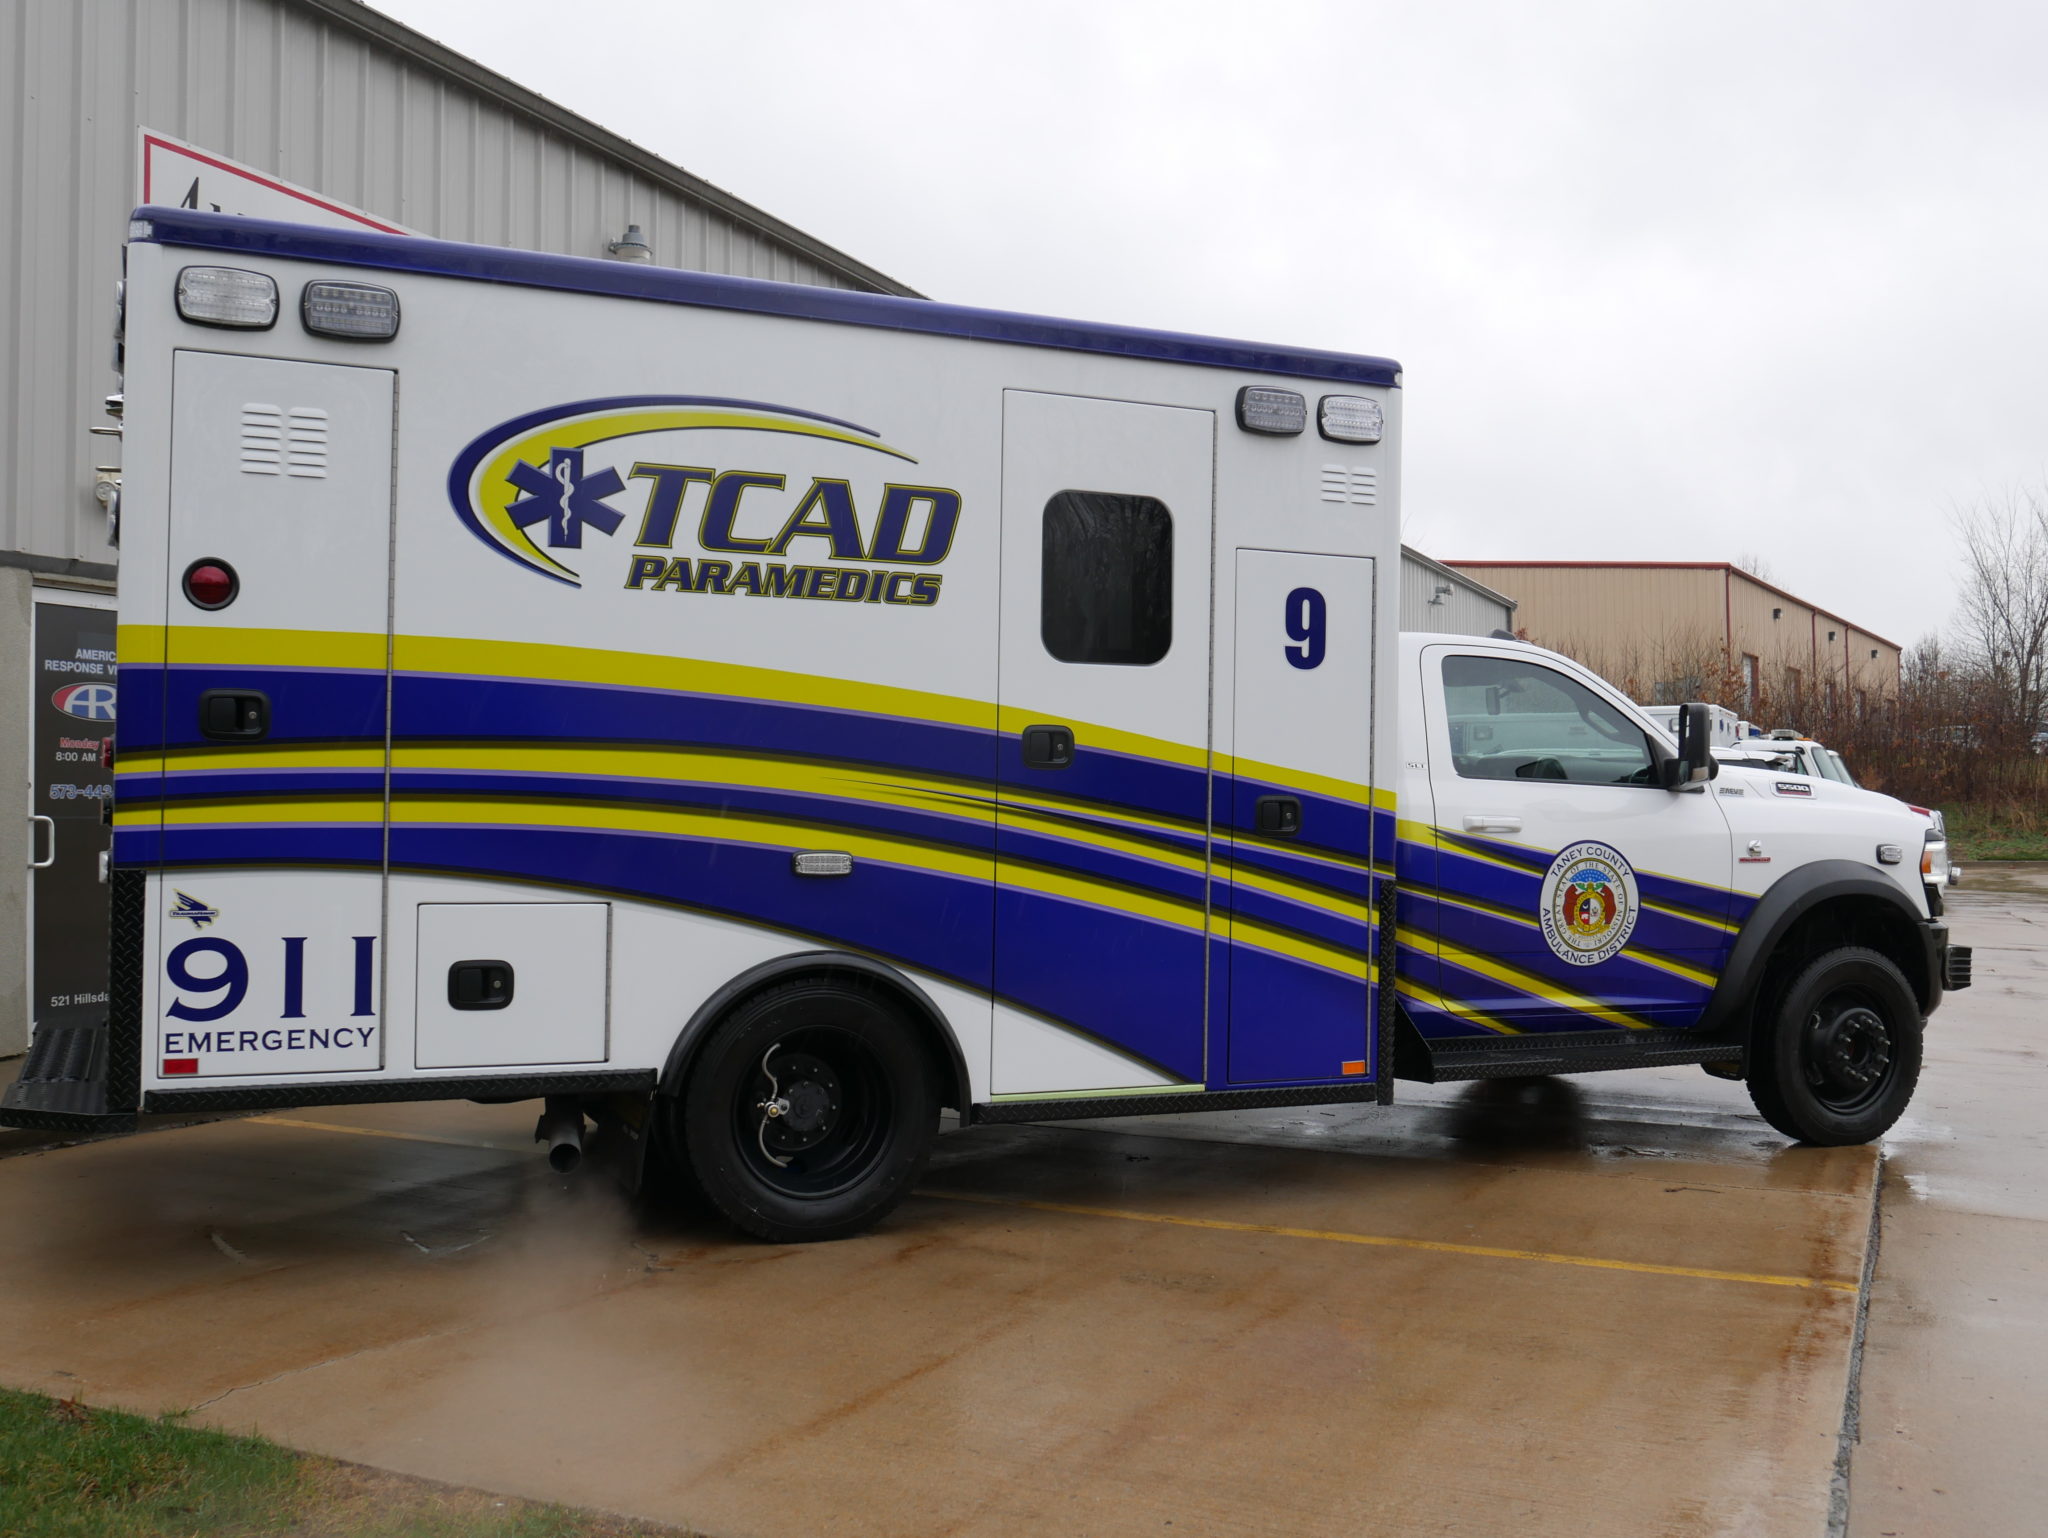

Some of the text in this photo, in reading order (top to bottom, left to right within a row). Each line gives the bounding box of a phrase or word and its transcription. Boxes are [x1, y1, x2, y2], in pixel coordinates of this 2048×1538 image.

[627, 461, 962, 566] TCAD
[624, 554, 943, 607] PARAMEDICS
[1285, 587, 1326, 670] 9
[45, 660, 104, 674] RESPONSE
[56, 752, 96, 761] 8:00 AM
[60, 737, 99, 750] Monday
[1551, 846, 1630, 878] TANEY COUNTY
[1543, 908, 1595, 964] AMBULANCE
[1598, 906, 1636, 960] DISTRICT
[165, 937, 377, 1022] 911
[51, 995, 69, 1007] 521
[165, 1027, 375, 1054] EMERGENCY
